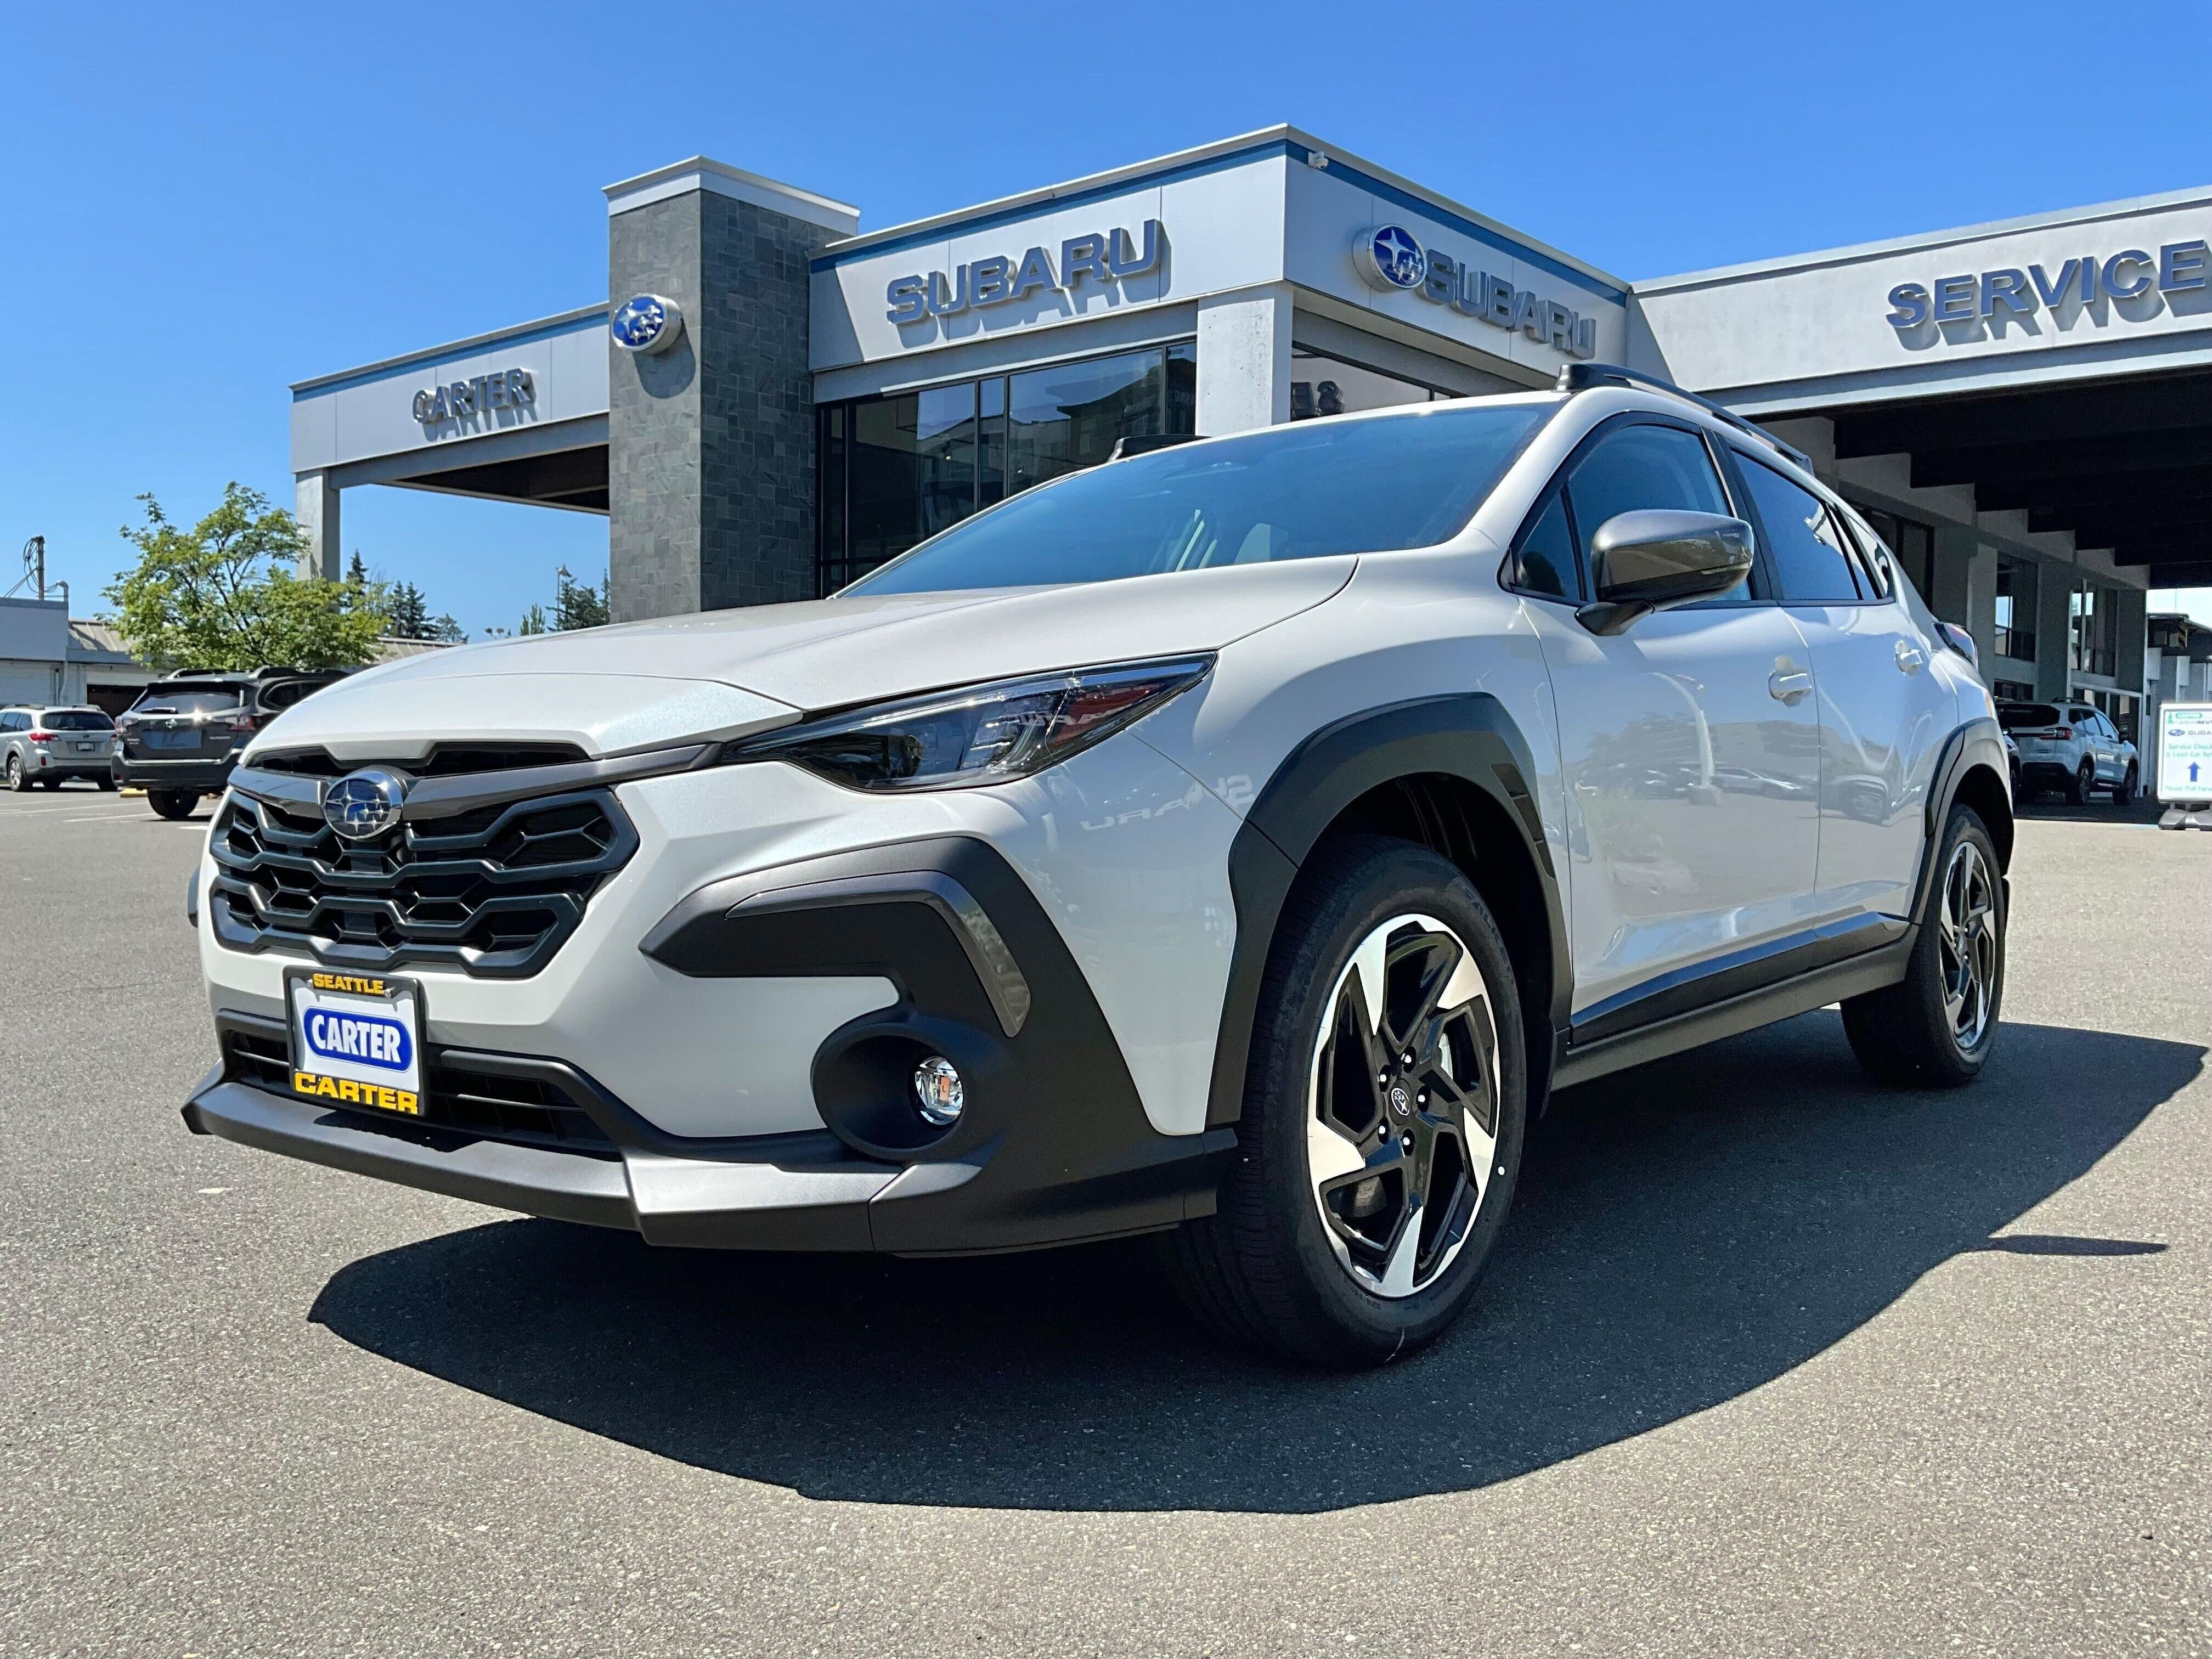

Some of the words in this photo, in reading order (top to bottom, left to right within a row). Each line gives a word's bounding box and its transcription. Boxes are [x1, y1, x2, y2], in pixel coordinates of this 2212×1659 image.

[887, 219, 1161, 325] SUBARU
[1886, 240, 2205, 329] SERVICE
[1422, 249, 1595, 359] SUBARU
[413, 368, 535, 422] CARTER
[313, 973, 385, 995] SEATTLE
[312, 1014, 401, 1063] CARTER
[295, 1071, 418, 1115] CARTER
